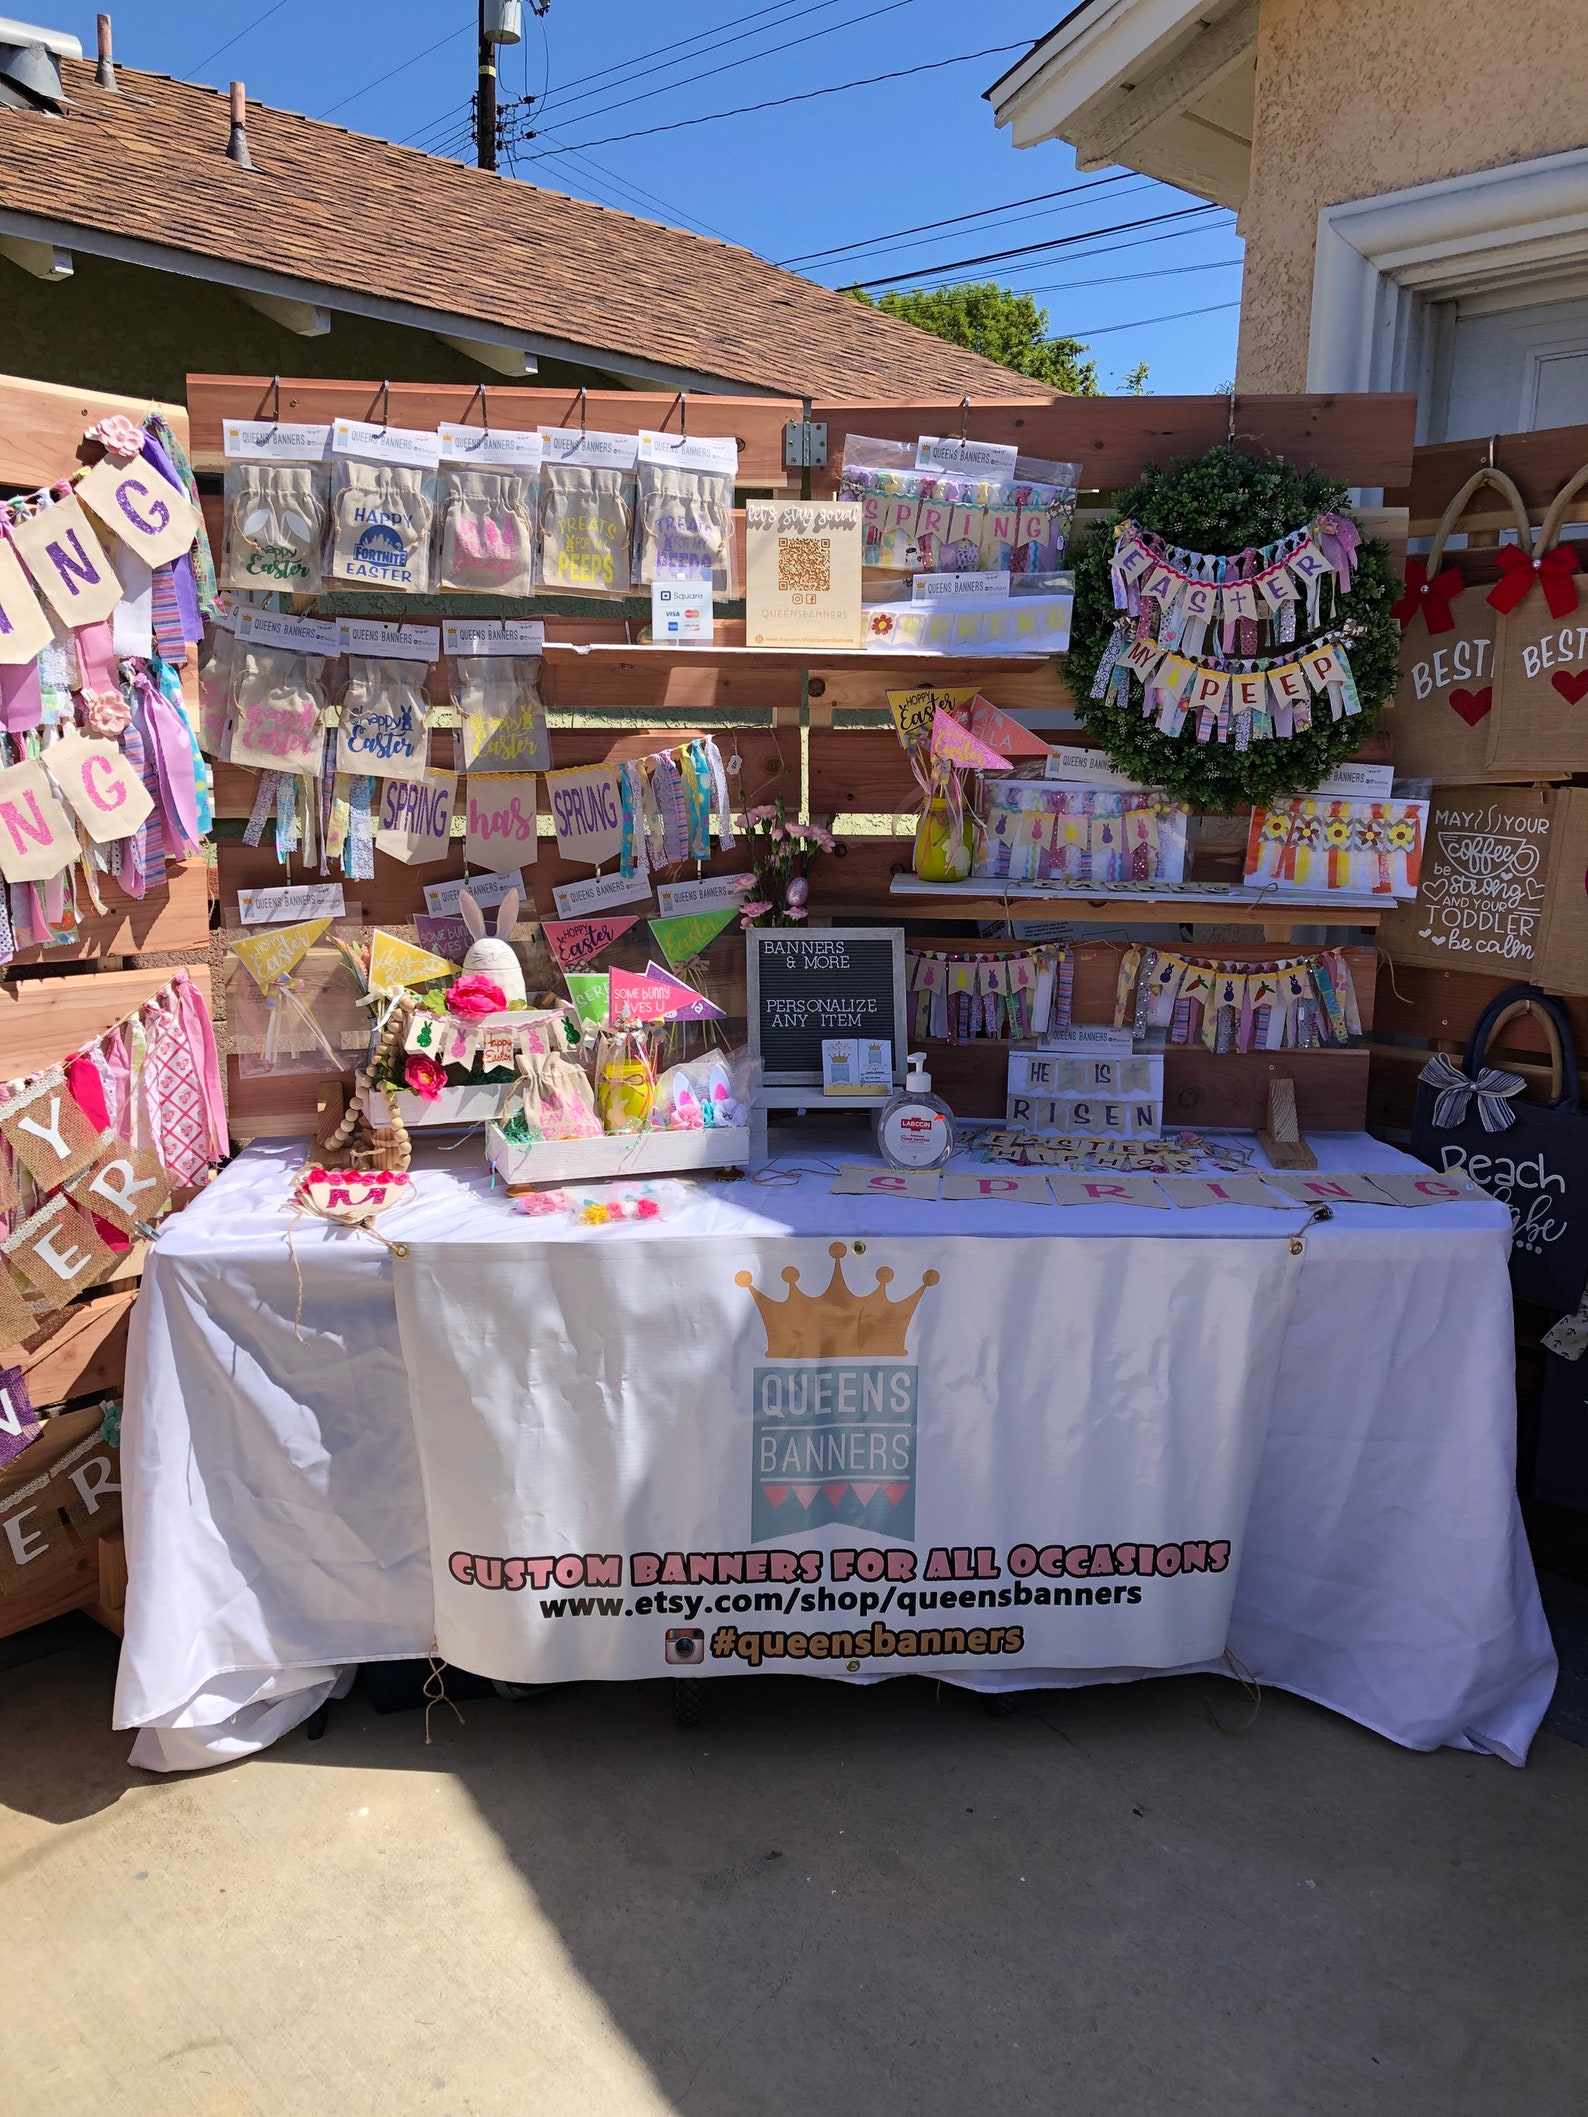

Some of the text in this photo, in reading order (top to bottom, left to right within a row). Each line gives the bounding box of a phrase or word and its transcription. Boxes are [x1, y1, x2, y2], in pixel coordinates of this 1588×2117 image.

[242, 431, 305, 446] QUEENS BANNERS
[351, 431, 413, 450] QUEENS BANNERS
[483, 439, 515, 450] BANNERS
[582, 440, 612, 453] BANNERS
[681, 444, 711, 458] BANNERS
[933, 447, 958, 460] QUEENS
[960, 451, 991, 464] BANNERS
[354, 507, 413, 528] HAPPY
[864, 499, 1042, 538] SPRING
[557, 516, 617, 540] TREATS
[576, 537, 590, 548] FOR
[246, 553, 310, 579] Easter
[355, 549, 407, 566] FORTNITE
[557, 550, 614, 584] PEEPS
[346, 563, 412, 583] EASTER
[673, 591, 704, 601] Square
[928, 582, 952, 594] QUEENS
[954, 580, 984, 593] BANNERS
[761, 609, 848, 620] QUEENSBANNERS
[254, 618, 281, 634] QUEENS
[283, 624, 315, 639] BANNERS
[352, 628, 379, 642] QUEENS
[381, 631, 413, 645] BANNERS
[459, 629, 486, 641] QUEENS
[488, 629, 519, 641] BANNERS
[1522, 627, 1588, 679] BEST
[1128, 642, 1332, 704] MY PEEP
[1411, 638, 1492, 700] BEST
[906, 690, 931, 707] HOPPY
[347, 725, 415, 758] Easter
[473, 730, 537, 761] Easter
[1062, 754, 1112, 771] QUEENS BANNE
[1333, 771, 1365, 783] BANNERS
[383, 781, 619, 841] SPRING has SPRUNG
[1435, 809, 1550, 835] MAY YOUR
[1448, 836, 1515, 874] coffee
[1434, 862, 1451, 876] be
[441, 883, 498, 903] QUEEN BANNERS
[569, 886, 595, 903] QUEENS
[596, 880, 625, 897] BANNERS
[673, 886, 727, 904] QUEENS BANNERS
[1450, 874, 1526, 909] strong
[255, 894, 317, 910] QUEENS BANNERS
[1442, 895, 1508, 913] AND YOUR
[1425, 904, 1535, 937] TODDLER
[563, 923, 588, 939] HOPPY
[559, 925, 615, 961] Easter
[764, 941, 845, 954] BANNERS
[1448, 928, 1535, 960] be calm
[250, 930, 310, 979] Easter
[786, 956, 850, 969] & MORE
[614, 988, 640, 999] SOME
[656, 1001, 665, 1012] U
[766, 999, 877, 1013] PERSONALIZE
[771, 1013, 862, 1027] ANY ITEM
[1053, 1031, 1077, 1042] QUEENS
[1079, 1031, 1108, 1043] BANNERS
[1030, 1062, 1112, 1084] HE IS
[1013, 1099, 1153, 1126] RISEN
[867, 1175, 1461, 1199] SPRING
[761, 1371, 912, 1418] QUEENS
[760, 1432, 910, 1473] BANNERS
[448, 1540, 1231, 1591] CUSTOM BANNERS FOR ALL OCCASIONS
[540, 1581, 1142, 1620] www.etsy.com/shop/queensbanners
[709, 1621, 1025, 1667] #queensbanners
